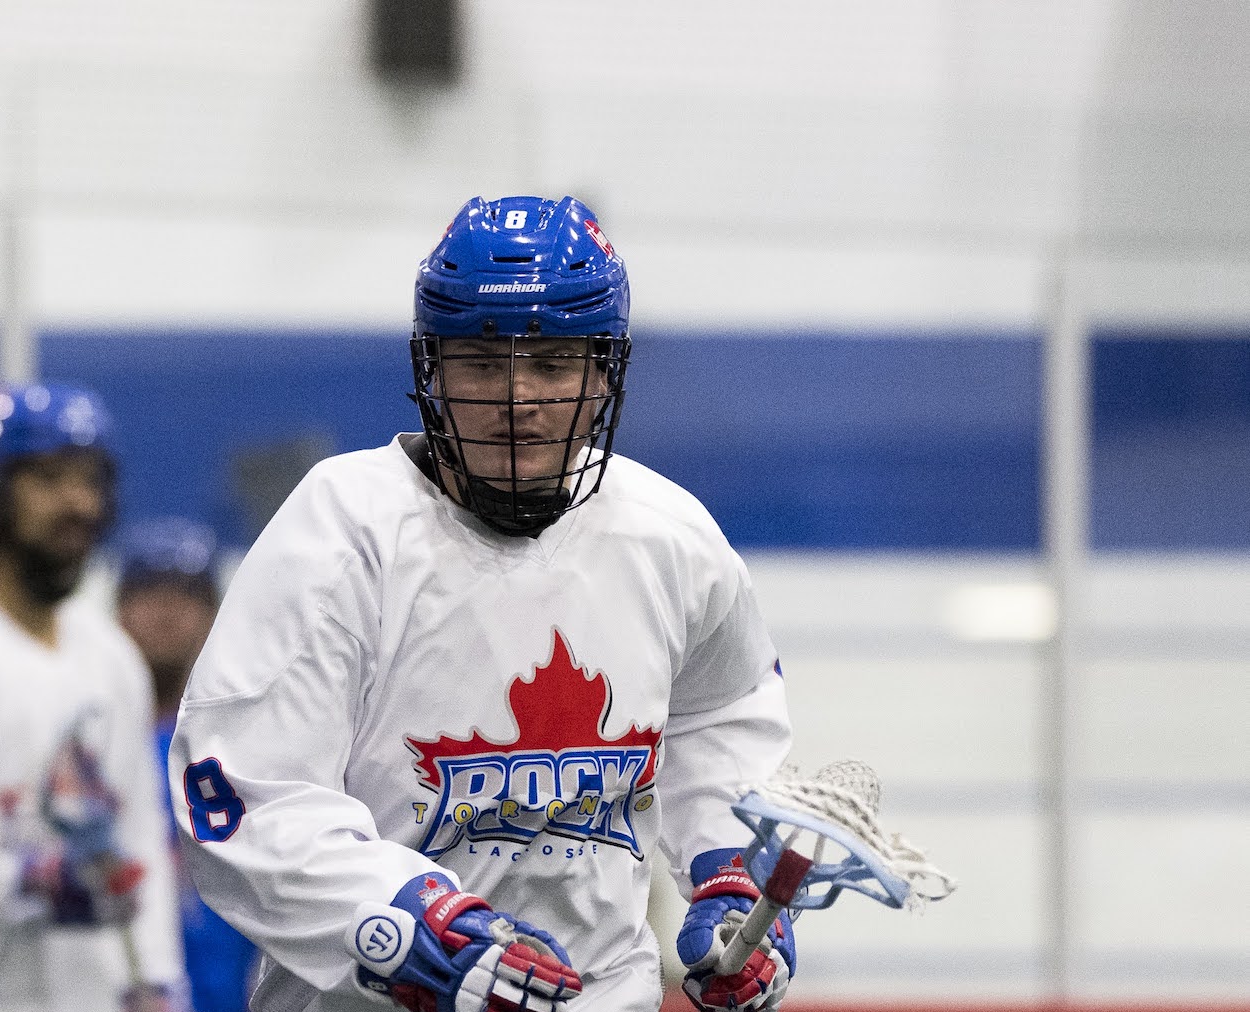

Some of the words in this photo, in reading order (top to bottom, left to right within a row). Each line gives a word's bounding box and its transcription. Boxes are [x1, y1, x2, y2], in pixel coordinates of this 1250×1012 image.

[504, 210, 528, 229] 8
[478, 283, 547, 294] WARRIOR
[183, 757, 246, 843] 8
[412, 794, 654, 825] TORONO
[423, 753, 646, 856] ROCK
[468, 844, 598, 863] LACOSSE
